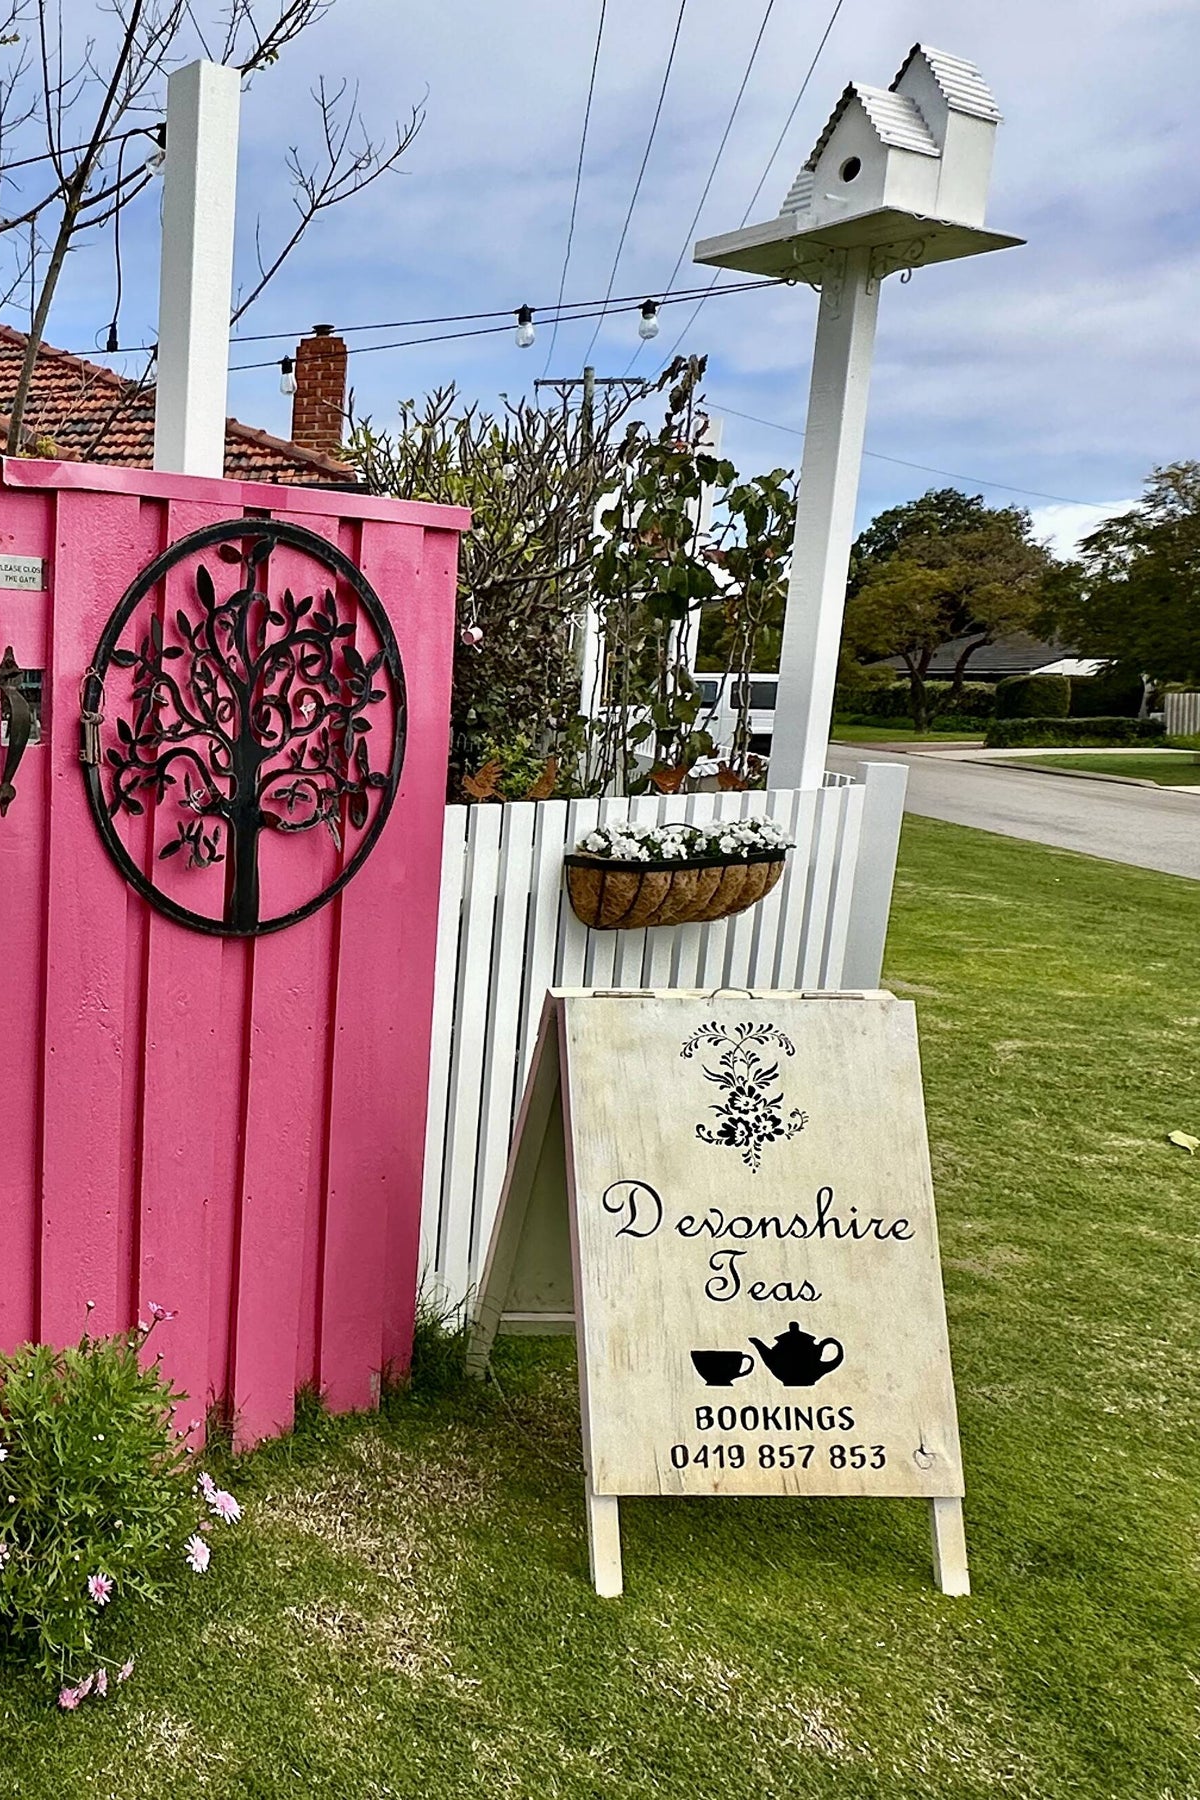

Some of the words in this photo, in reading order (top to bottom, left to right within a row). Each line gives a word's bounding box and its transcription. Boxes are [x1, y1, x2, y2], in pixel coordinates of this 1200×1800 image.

[602, 1179, 915, 1241] Devonshire
[704, 1249, 823, 1302] Teas
[695, 1405, 855, 1431] BOOKINGS
[670, 1444, 745, 1469] 0419
[758, 1444, 815, 1469] 857
[829, 1444, 886, 1470] 853
